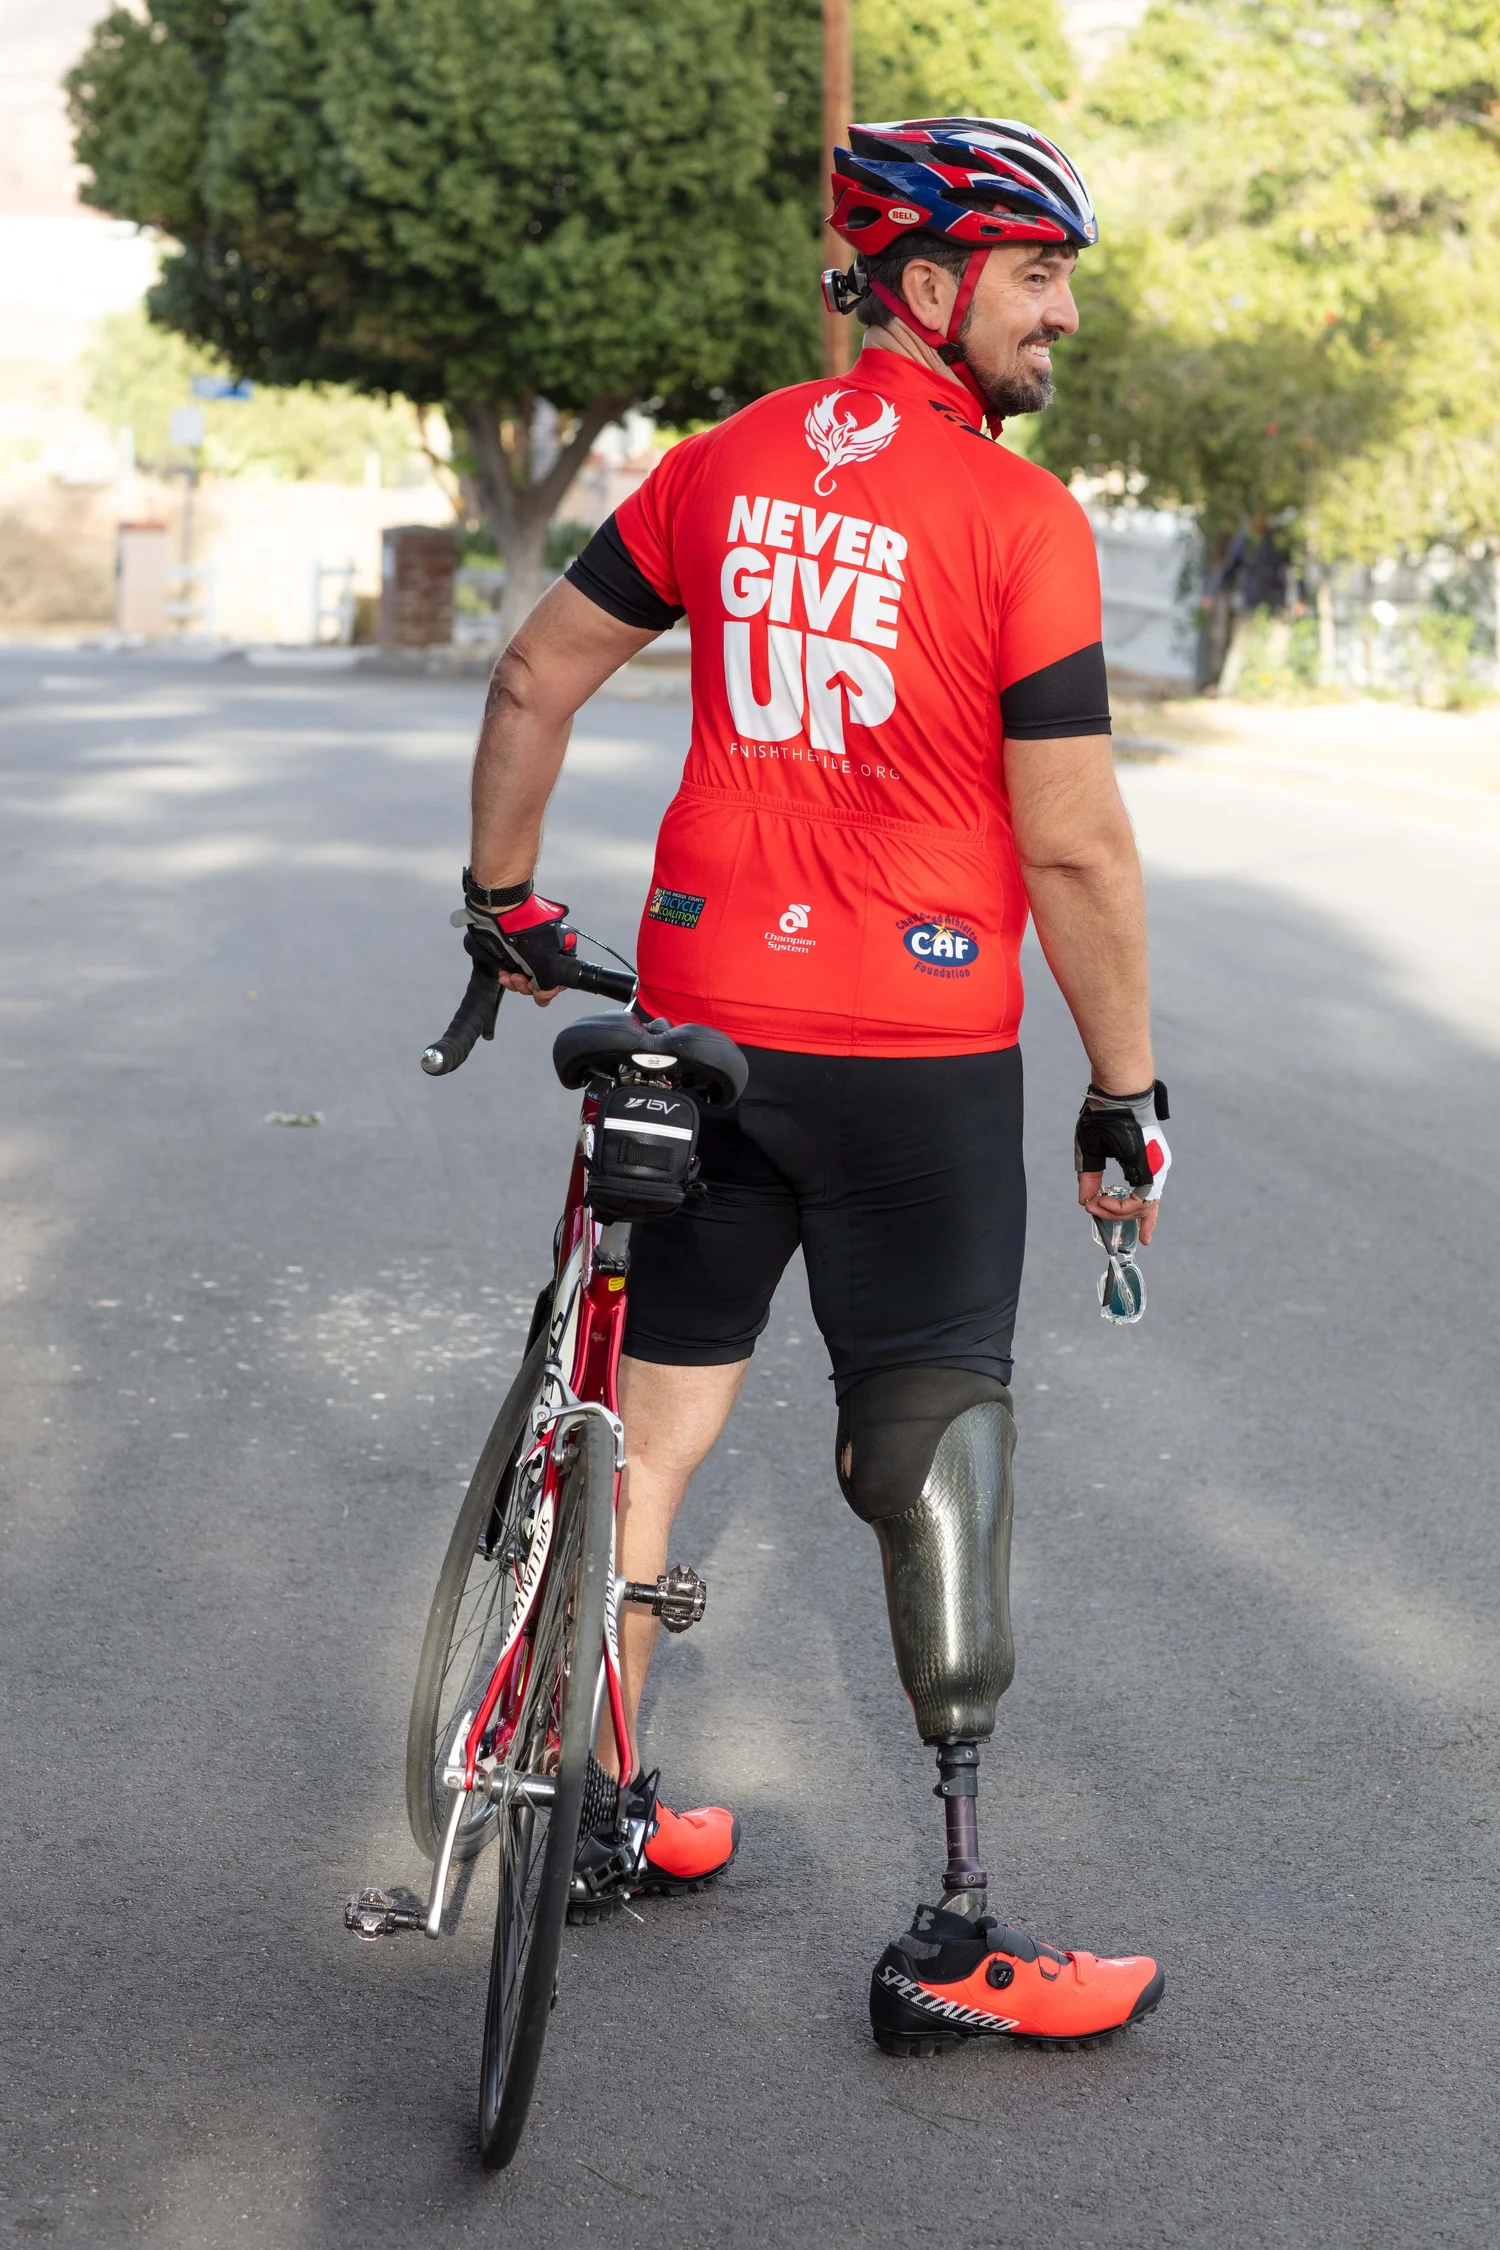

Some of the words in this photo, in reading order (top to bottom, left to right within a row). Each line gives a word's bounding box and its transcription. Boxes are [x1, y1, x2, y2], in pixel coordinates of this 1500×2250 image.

[892, 211, 914, 220] BELL
[727, 495, 908, 583] NEVER
[720, 546, 901, 650] GIVE
[723, 620, 897, 755] UP
[661, 895, 703, 914] BICYCLE
[687, 895, 705, 903] COUNTY
[658, 907, 698, 923] COALITION
[895, 912, 942, 930] Challeed
[944, 914, 978, 941] Athletes
[764, 932, 816, 946] Champion
[767, 941, 809, 953] System
[911, 931, 969, 959] CAF
[913, 961, 971, 979] Foundation
[877, 1965, 1020, 2031] SPECIALIZED
